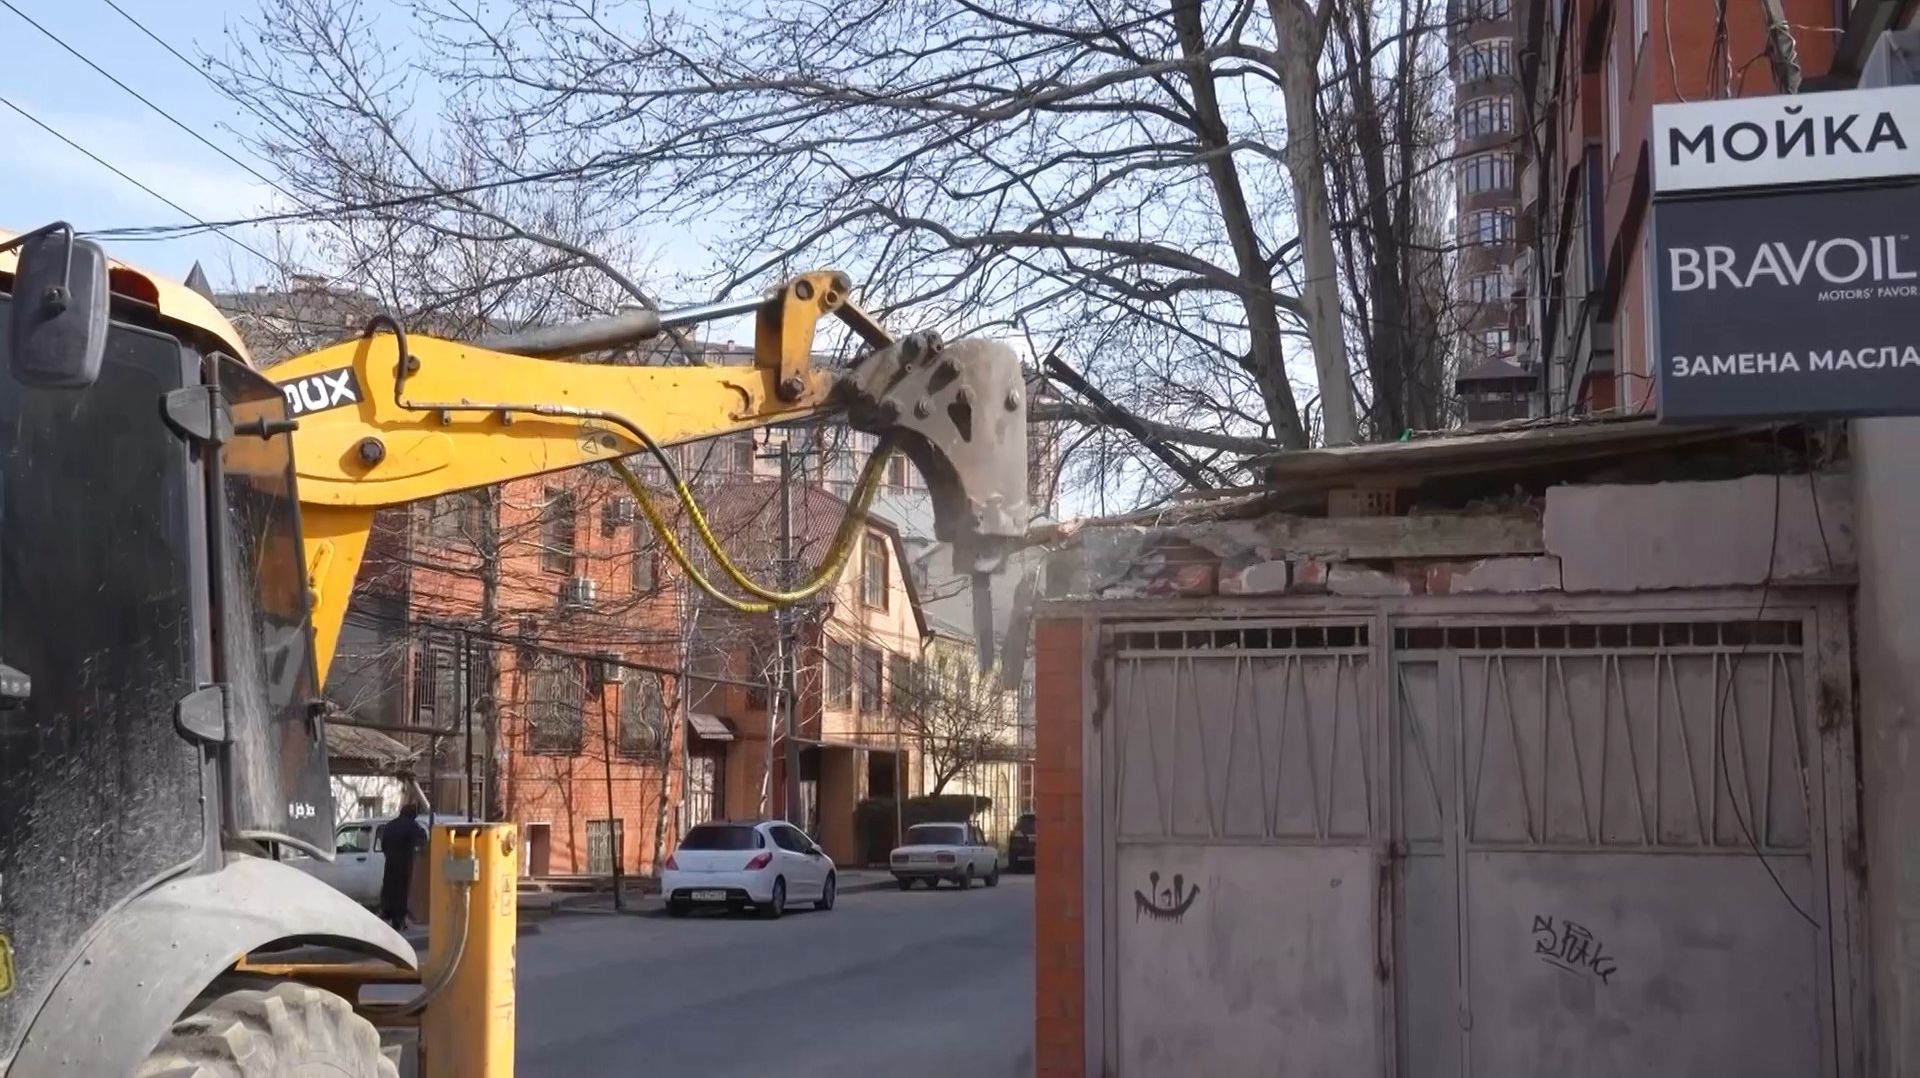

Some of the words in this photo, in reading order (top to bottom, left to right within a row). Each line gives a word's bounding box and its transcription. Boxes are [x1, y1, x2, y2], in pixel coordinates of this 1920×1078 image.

[1668, 105, 1908, 167] МОЙКА
[1668, 235, 1917, 291] BRAVOIL
[1878, 285, 1920, 298] FAVOR
[1672, 352, 1800, 377] ЗАМЕНА
[1809, 345, 1920, 371] МАСЛА
